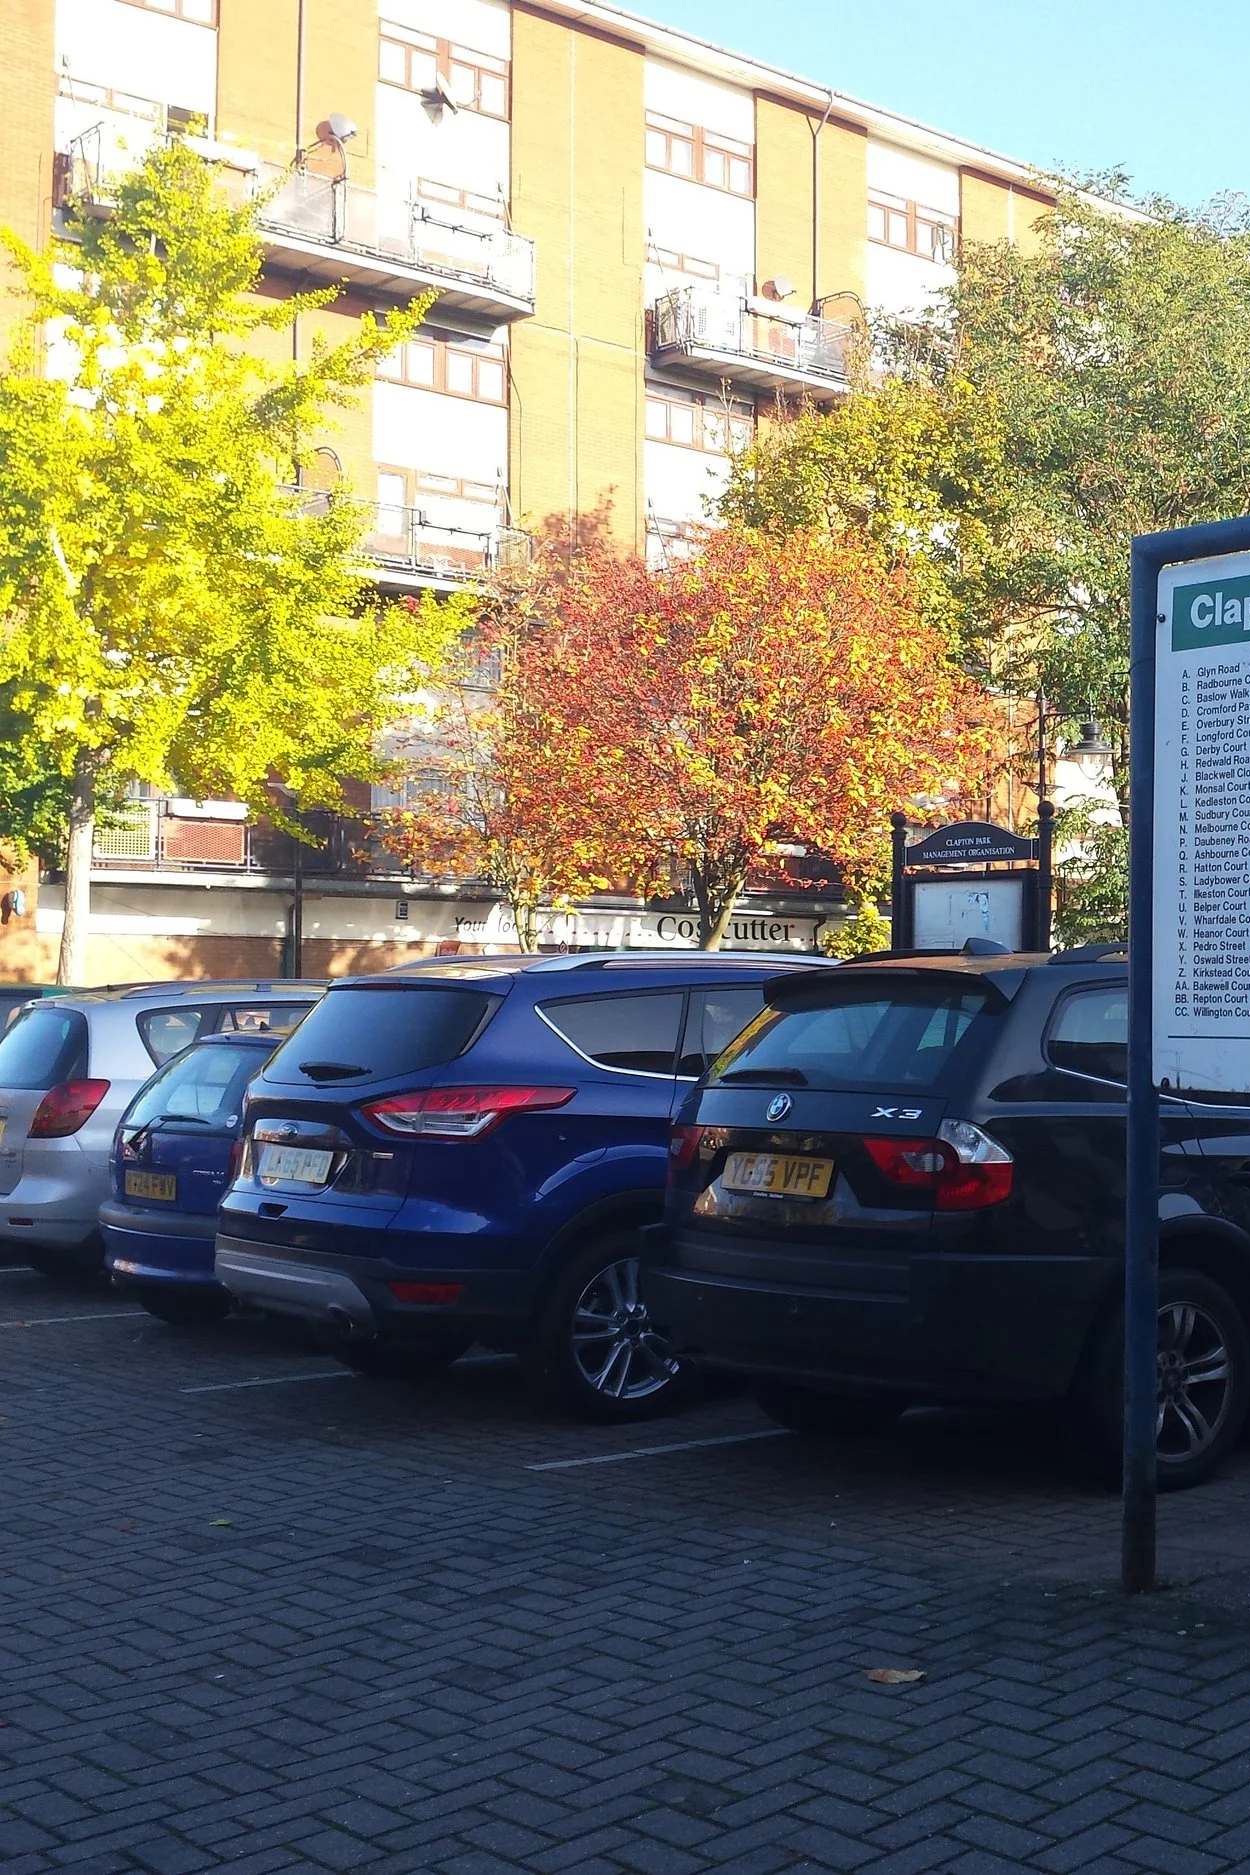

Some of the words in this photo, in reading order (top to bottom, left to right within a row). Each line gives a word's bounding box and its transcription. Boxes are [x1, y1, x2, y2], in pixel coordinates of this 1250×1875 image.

[1182, 670, 1190, 678] A.
[1198, 667, 1216, 678] Glyn
[1218, 663, 1240, 674] Road
[1182, 683, 1190, 692] B.
[1197, 678, 1242, 690] Radbourne
[1182, 696, 1190, 704] C.
[1197, 691, 1227, 703] Baslow
[1230, 688, 1250, 698] Walk
[1182, 709, 1189, 718] D.
[1197, 704, 1236, 716] Cromford
[1182, 722, 1189, 730] E.
[1197, 716, 1235, 729] Overbury
[1182, 735, 1188, 743] F.
[1197, 730, 1234, 743] Longford
[1181, 748, 1189, 756] G.
[1196, 744, 1220, 756] Derby
[1223, 742, 1247, 752] Court
[1181, 761, 1188, 769] H.
[1196, 756, 1231, 768] Redwald
[1181, 774, 1188, 782] J.
[1196, 769, 1235, 781] Blackwell
[1180, 787, 1188, 795] K.
[1196, 782, 1225, 794] Monsal
[1228, 781, 1250, 791] Court
[1180, 799, 1188, 808] L.
[1195, 795, 1236, 807] Kedleston
[1179, 813, 1188, 821] M.
[1195, 808, 1229, 820] Sudbury
[1180, 825, 1188, 834] N.
[1195, 821, 1238, 833] Melbourne
[946, 838, 974, 846] CLAPTON
[1180, 838, 1187, 847] P.
[1195, 836, 1236, 846] Daubeney
[923, 850, 966, 859] MANAGEMENT
[968, 847, 1015, 856] ORGANISATION
[1179, 852, 1188, 860] Q.
[1195, 849, 1239, 859] Ashbourne
[1179, 864, 1187, 873] R.
[1194, 862, 1221, 872] Hatton
[1224, 862, 1248, 871] Court
[1179, 877, 1187, 886] S.
[1194, 875, 1240, 887] Ladybower
[1179, 890, 1186, 899] T.
[1194, 888, 1225, 899] Ilkeston
[1228, 888, 1250, 897] Court
[1179, 903, 1186, 912] U.
[1194, 902, 1220, 913] Belper
[1223, 902, 1246, 911] Court
[455, 916, 487, 932] Your
[1179, 916, 1186, 925] V.
[1194, 915, 1236, 925] Wharfdale
[1178, 929, 1188, 938] W.
[1193, 929, 1222, 938] Heanor
[1225, 928, 1249, 938] Court
[1179, 942, 1186, 951] X.
[1193, 942, 1217, 951] Pedro
[1220, 941, 1246, 951] Street
[1179, 955, 1186, 964] Y.
[1193, 955, 1223, 964] Oswald
[1179, 968, 1186, 977] Z.
[1193, 968, 1232, 977] Kirkstead
[1175, 981, 1189, 990] AA.
[1193, 981, 1229, 991] Bakewell
[1175, 994, 1188, 1003] BB.
[1193, 994, 1222, 1004] Repton
[1224, 994, 1248, 1003] Court
[1175, 1007, 1189, 1017] CC.
[1193, 1007, 1232, 1018] Willington
[870, 1106, 923, 1120] X3
[783, 1160, 825, 1191] VPF
